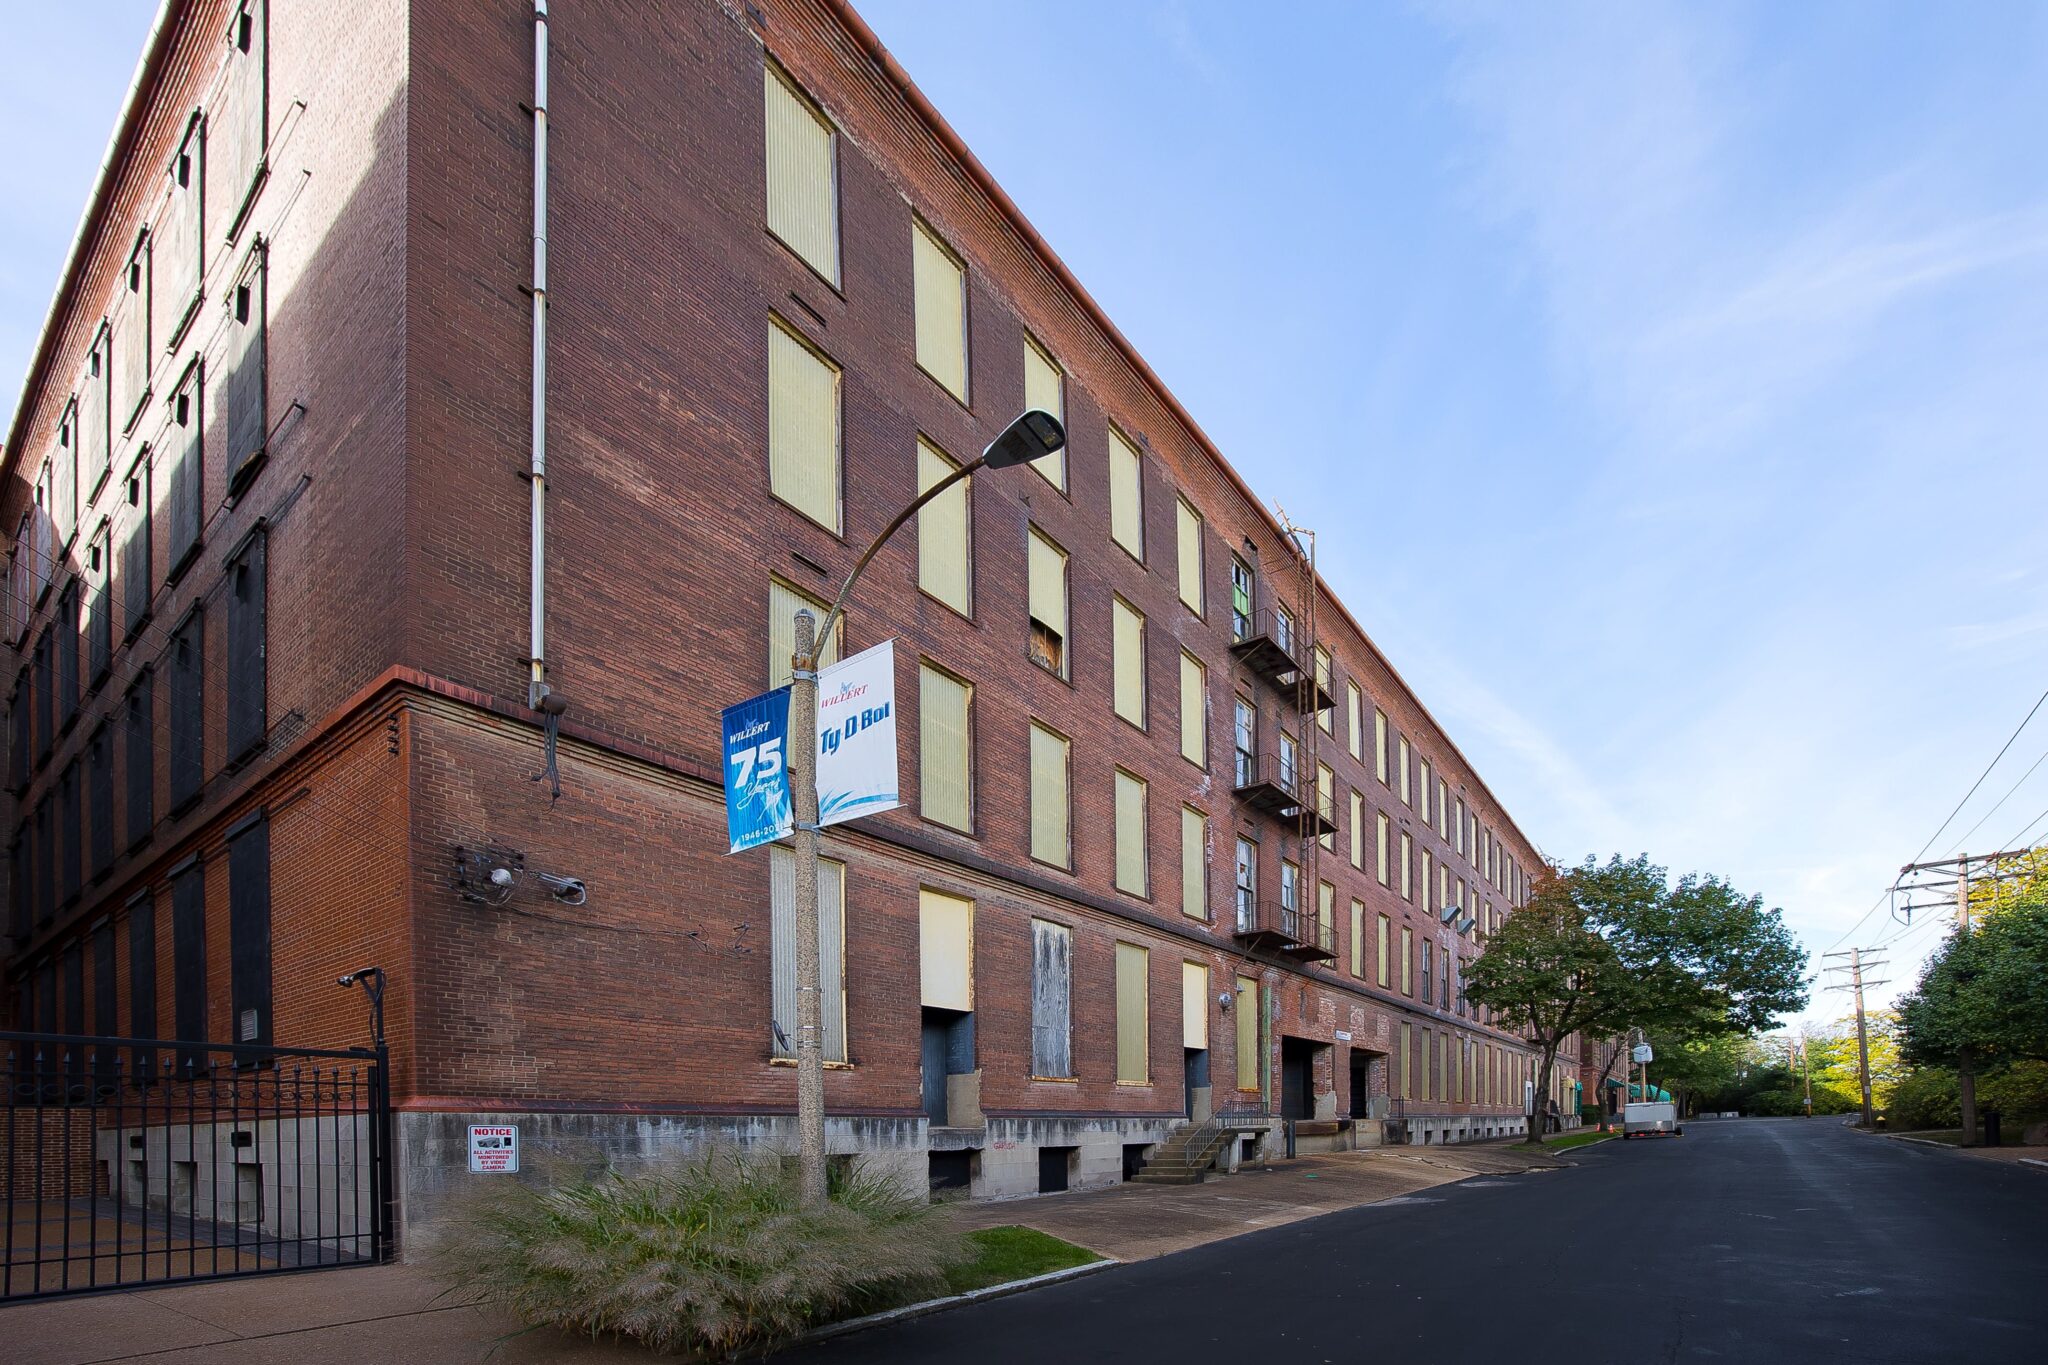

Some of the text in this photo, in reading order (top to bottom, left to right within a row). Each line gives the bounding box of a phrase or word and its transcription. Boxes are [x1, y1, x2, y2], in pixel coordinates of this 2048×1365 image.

[821, 684, 868, 708] WILLERT
[730, 721, 770, 744] WILLERT
[820, 701, 889, 756] Ty D Bol
[731, 736, 782, 789] 75
[474, 1128, 512, 1136] NOTICE
